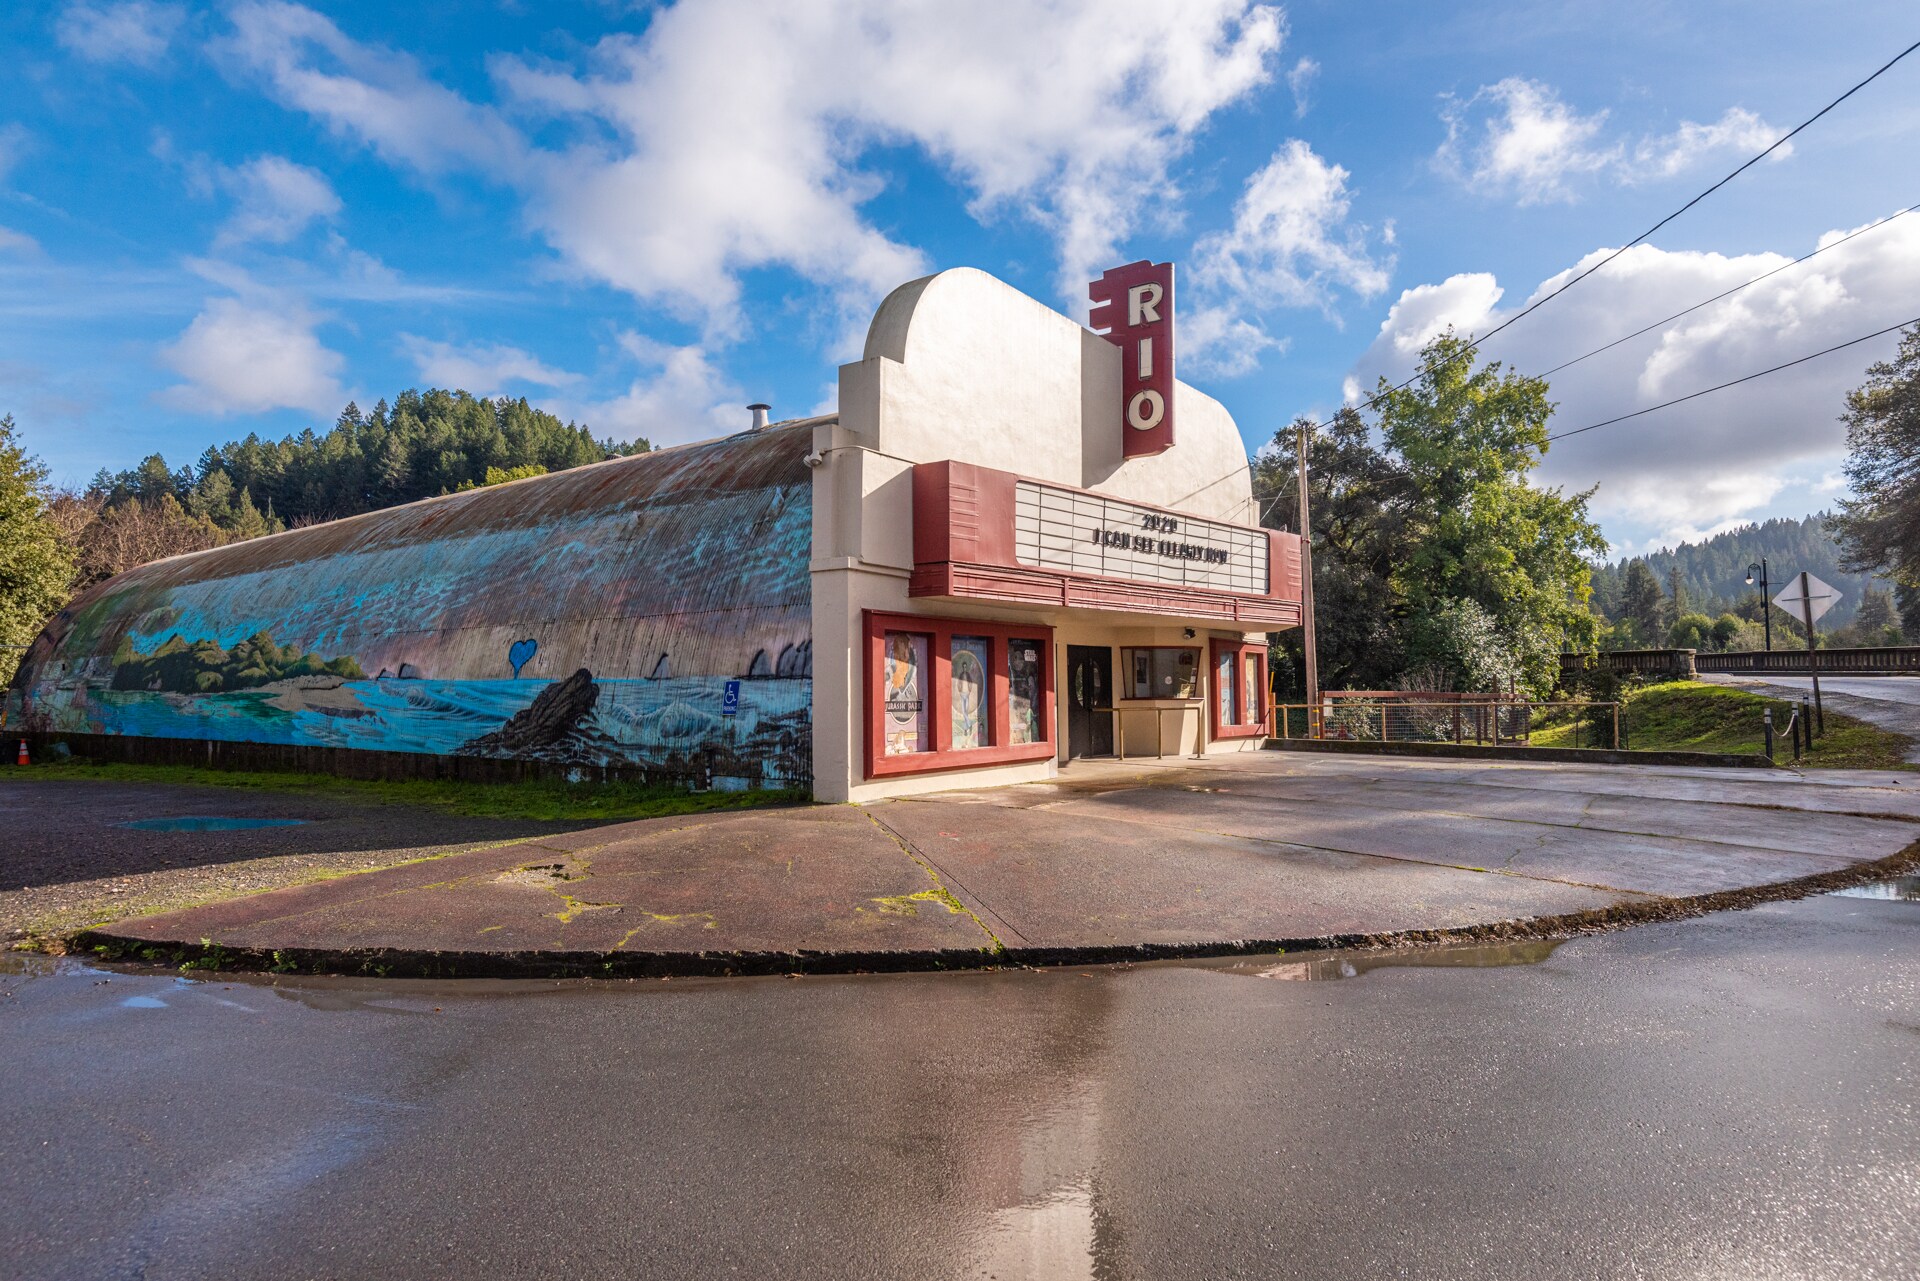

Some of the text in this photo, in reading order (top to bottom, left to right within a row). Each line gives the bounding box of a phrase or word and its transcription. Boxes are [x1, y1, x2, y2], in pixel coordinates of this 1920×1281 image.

[1126, 281, 1165, 431] RIO
[1141, 514, 1177, 534] 2020
[1092, 528, 1228, 565] I CAN SEE CLEARLY NOW
